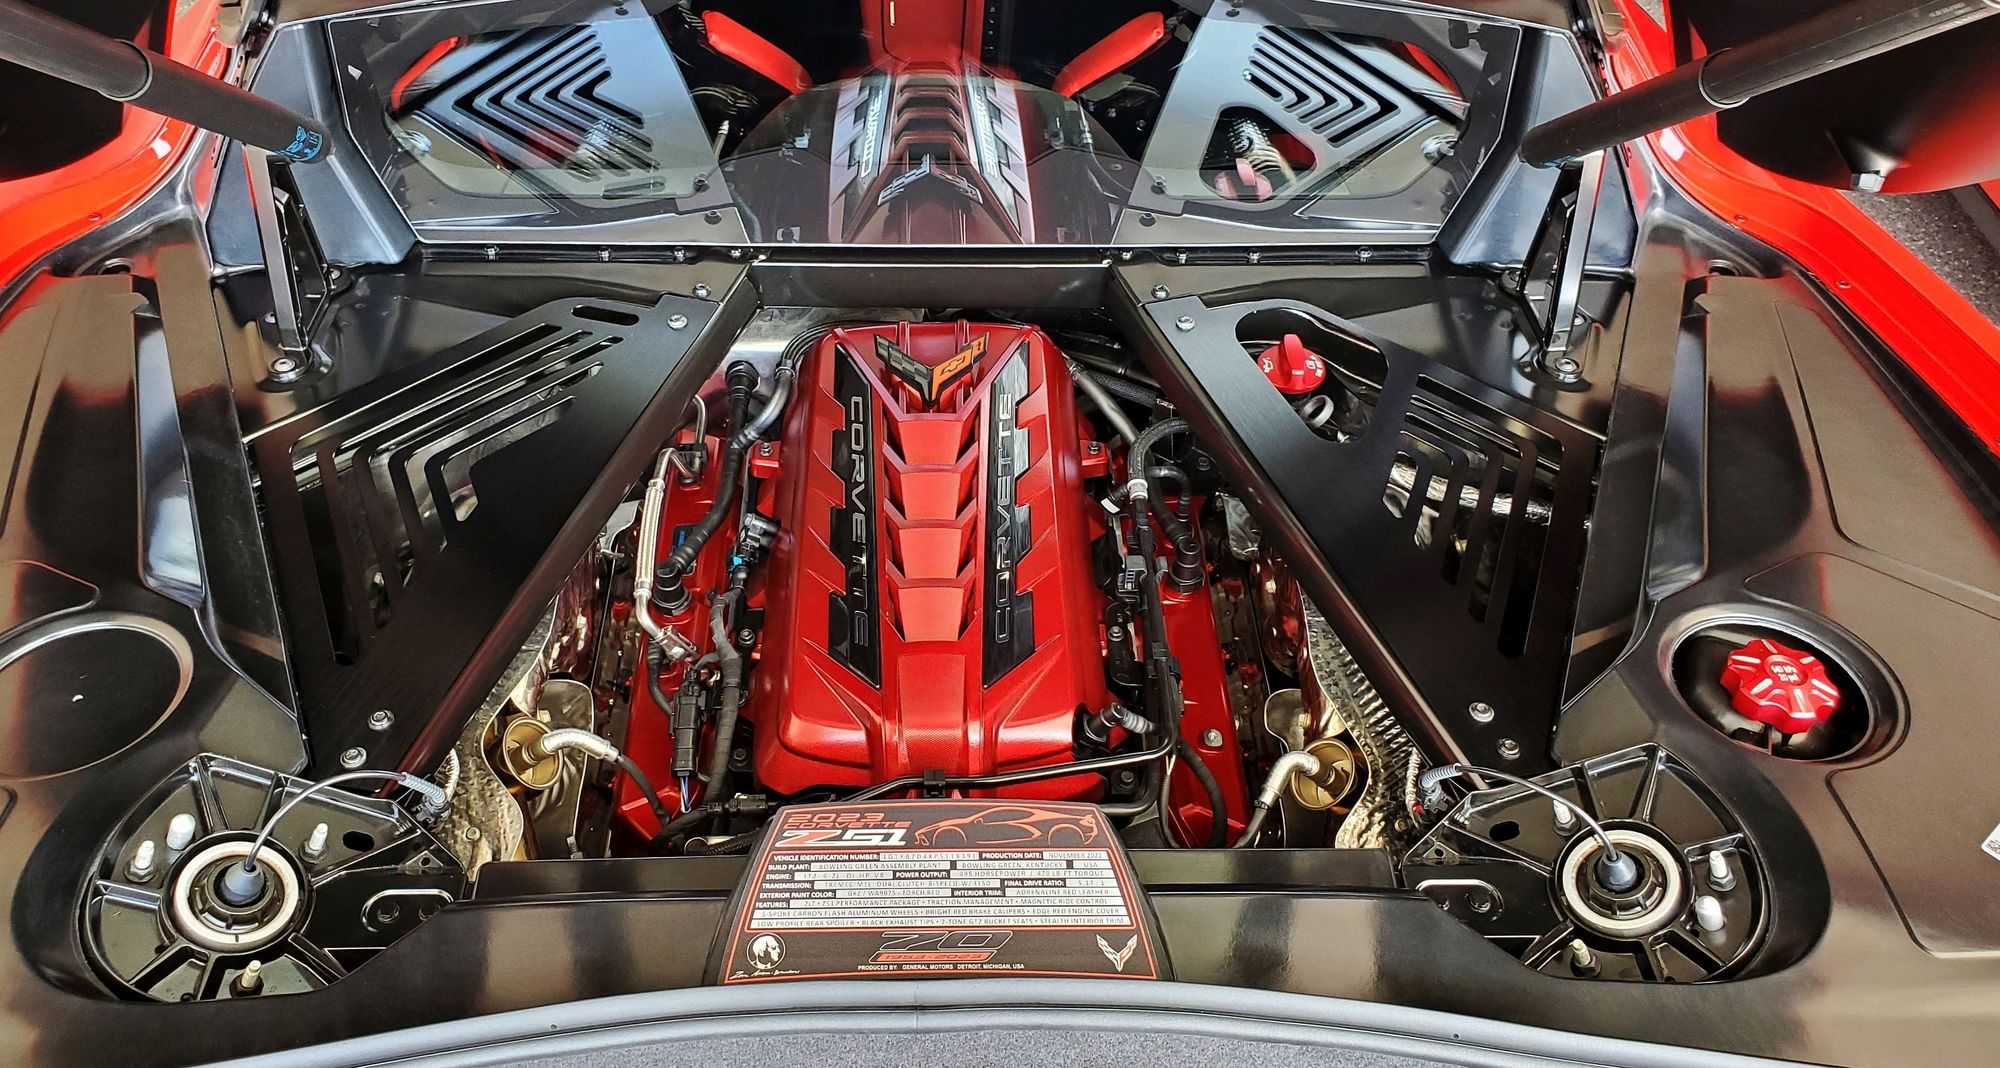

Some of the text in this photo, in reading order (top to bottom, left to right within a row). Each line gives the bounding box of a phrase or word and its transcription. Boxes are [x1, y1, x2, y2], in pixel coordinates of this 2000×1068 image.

[850, 396, 869, 647] CORVETTE
[995, 393, 1012, 644] CORVETTE
[784, 821, 912, 829] CORVETTE
[787, 812, 885, 822] 2023
[774, 828, 907, 848] Z51
[880, 930, 1014, 950] 70
